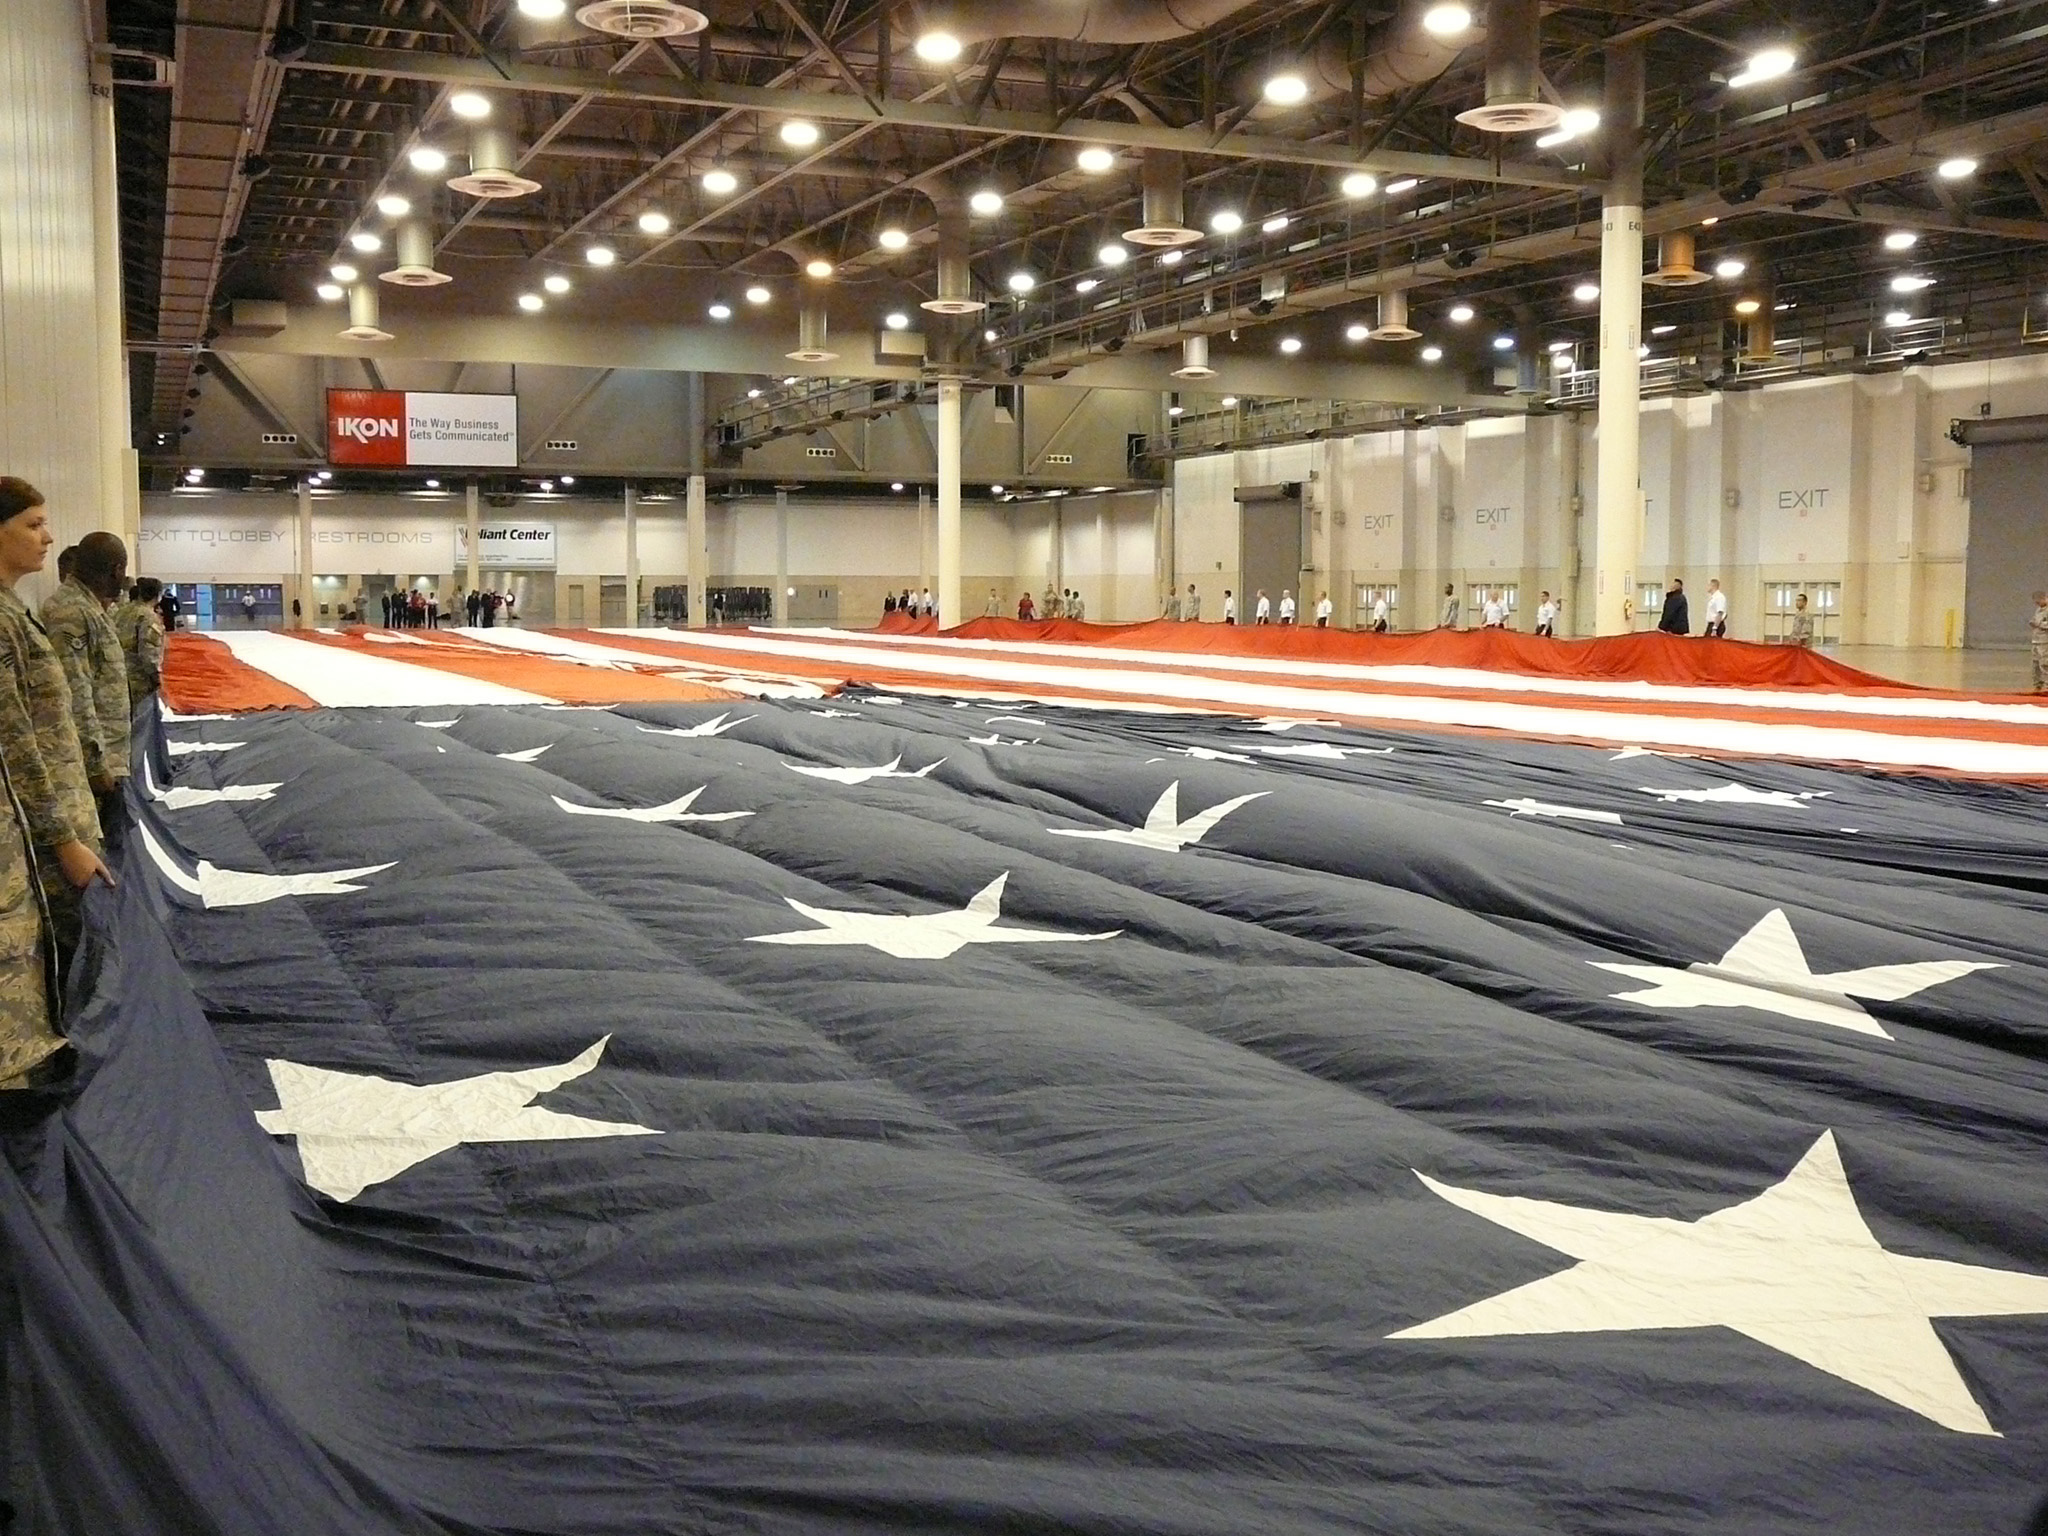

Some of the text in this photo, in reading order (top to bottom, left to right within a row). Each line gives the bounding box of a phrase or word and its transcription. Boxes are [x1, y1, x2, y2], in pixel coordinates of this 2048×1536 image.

[337, 417, 399, 444] IKON
[409, 417, 499, 431] The Way Business
[409, 430, 510, 442] Gets Communicated
[1778, 488, 1829, 509] EXIT
[1364, 514, 1394, 530] EXIT
[1476, 507, 1511, 524] EXIT
[138, 529, 286, 542] EXIT TO LOBBY
[311, 531, 433, 544] RESTROOMS
[510, 529, 551, 540] Center
